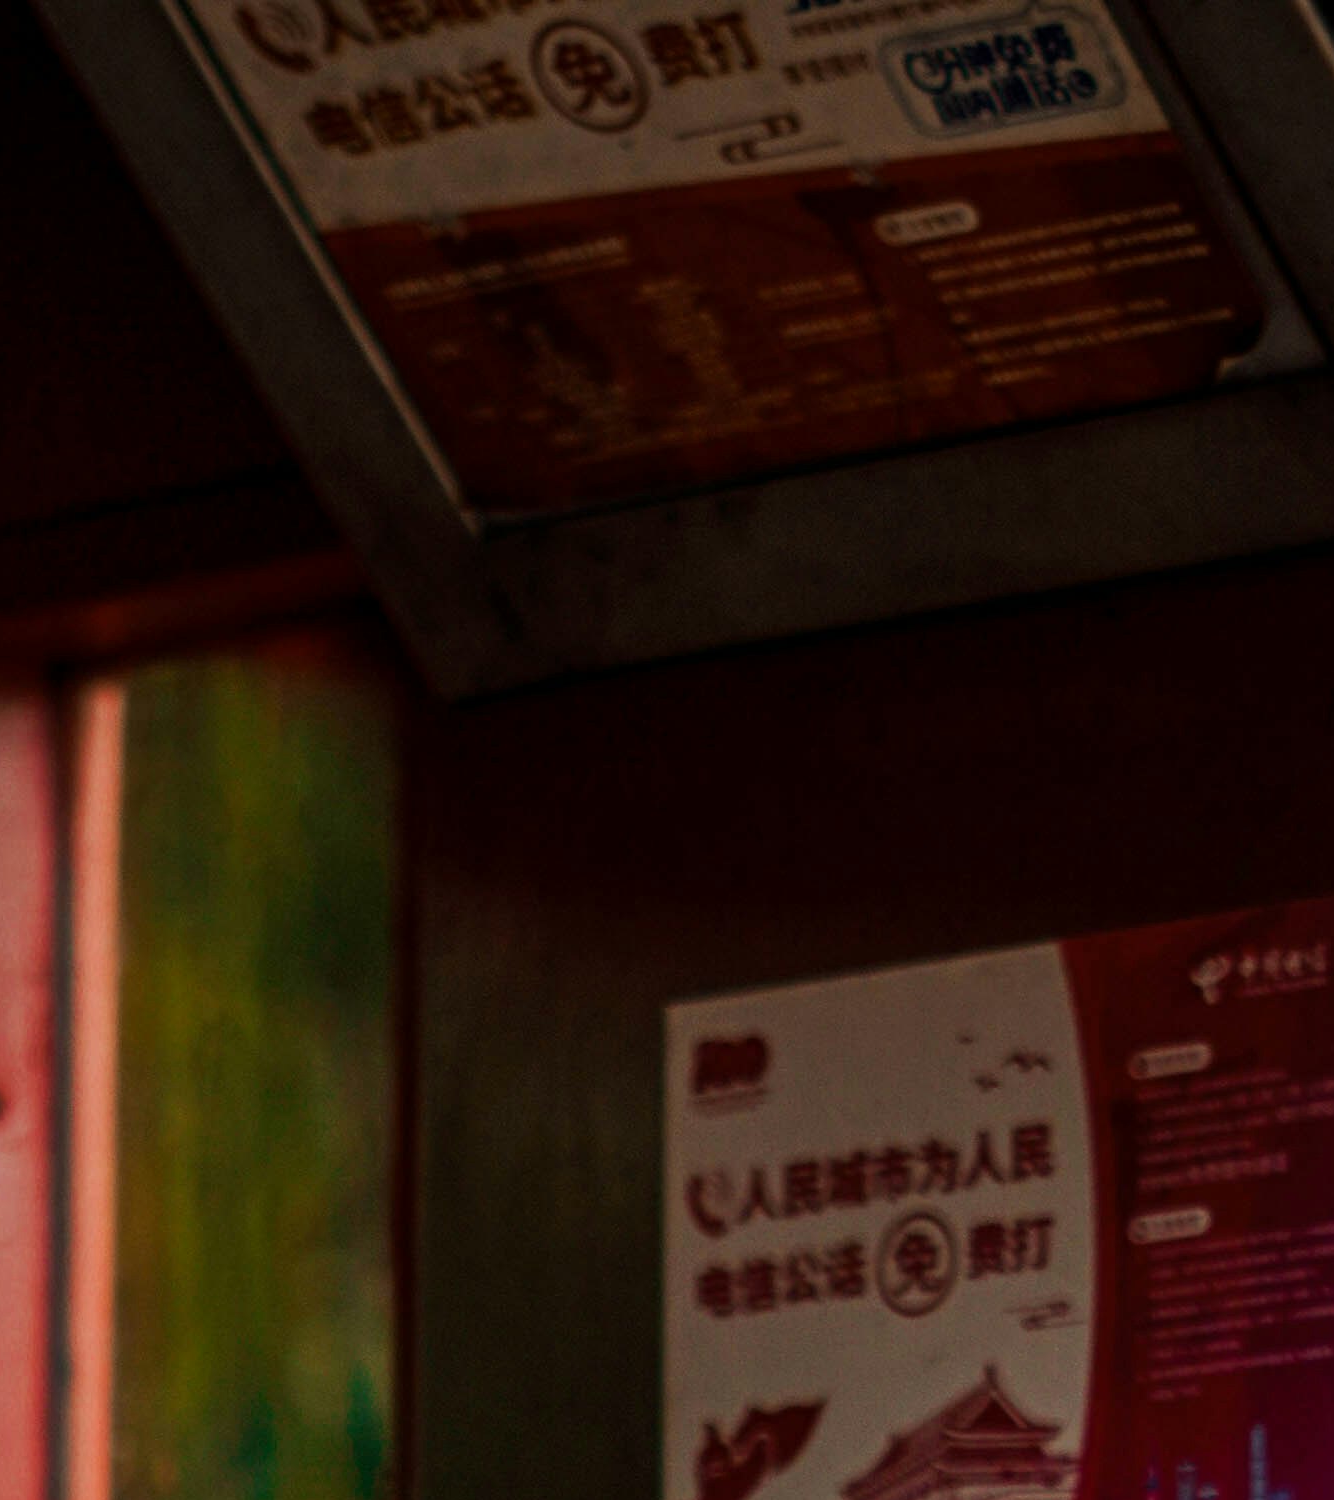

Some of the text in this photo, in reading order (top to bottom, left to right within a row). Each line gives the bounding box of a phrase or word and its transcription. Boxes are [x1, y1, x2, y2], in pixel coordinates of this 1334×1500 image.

[738, 1123, 1053, 1225] 人民城市为人民
[698, 1212, 1054, 1317] 电信公话免费打
